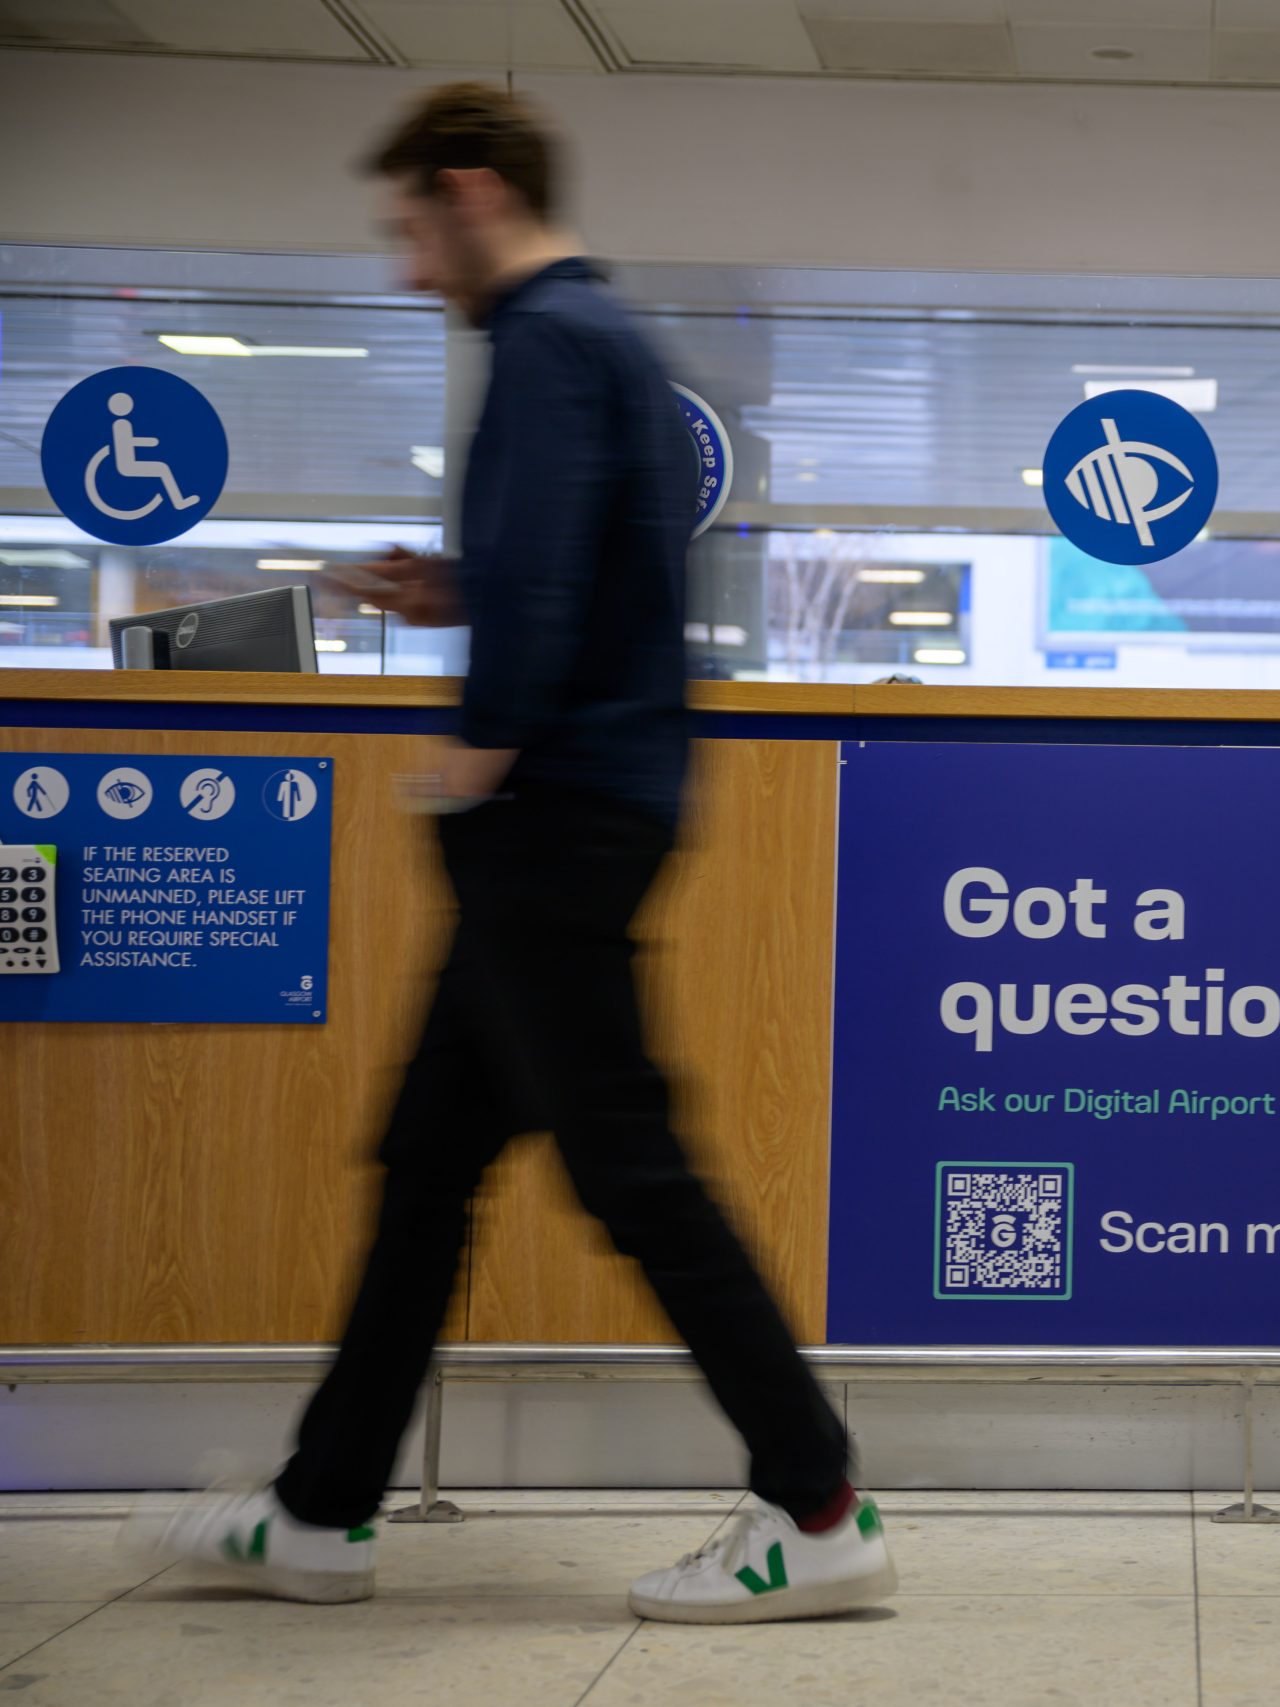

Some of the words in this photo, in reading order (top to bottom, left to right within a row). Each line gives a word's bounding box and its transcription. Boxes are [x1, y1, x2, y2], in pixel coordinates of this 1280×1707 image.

[691, 418, 716, 468] Keep
[83, 846, 98, 862] IF
[103, 846, 137, 862] THE
[142, 846, 230, 863] RESERVED
[1, 869, 10, 880] 2
[28, 869, 37, 880] 3
[82, 867, 161, 883] SEATING
[166, 868, 215, 883] AREA
[220, 868, 236, 884] IS
[1, 890, 10, 900] 5
[29, 889, 38, 900] 6
[82, 888, 202, 907] UNMANNED,
[208, 889, 269, 905] PLEASE
[274, 890, 306, 905] LIFT
[943, 866, 1107, 939] Got
[1133, 888, 1186, 940] a
[1, 909, 10, 921] 8
[28, 908, 37, 920] 9
[81, 909, 115, 925] THE
[120, 909, 186, 925] PHONE
[192, 910, 278, 926] HANDSET
[283, 911, 297, 926] IF
[2, 930, 11, 941] 0
[80, 930, 122, 946] YOU
[128, 930, 203, 946] REQUIRE
[209, 931, 279, 947] SPECIAL
[80, 951, 197, 968] ASSISTANCE.
[937, 1086, 997, 1112] Ask
[1004, 1093, 1055, 1113] our
[1064, 1088, 1160, 1120] Digital
[1168, 1089, 1276, 1120] Airport
[1099, 1210, 1229, 1253] Scan
